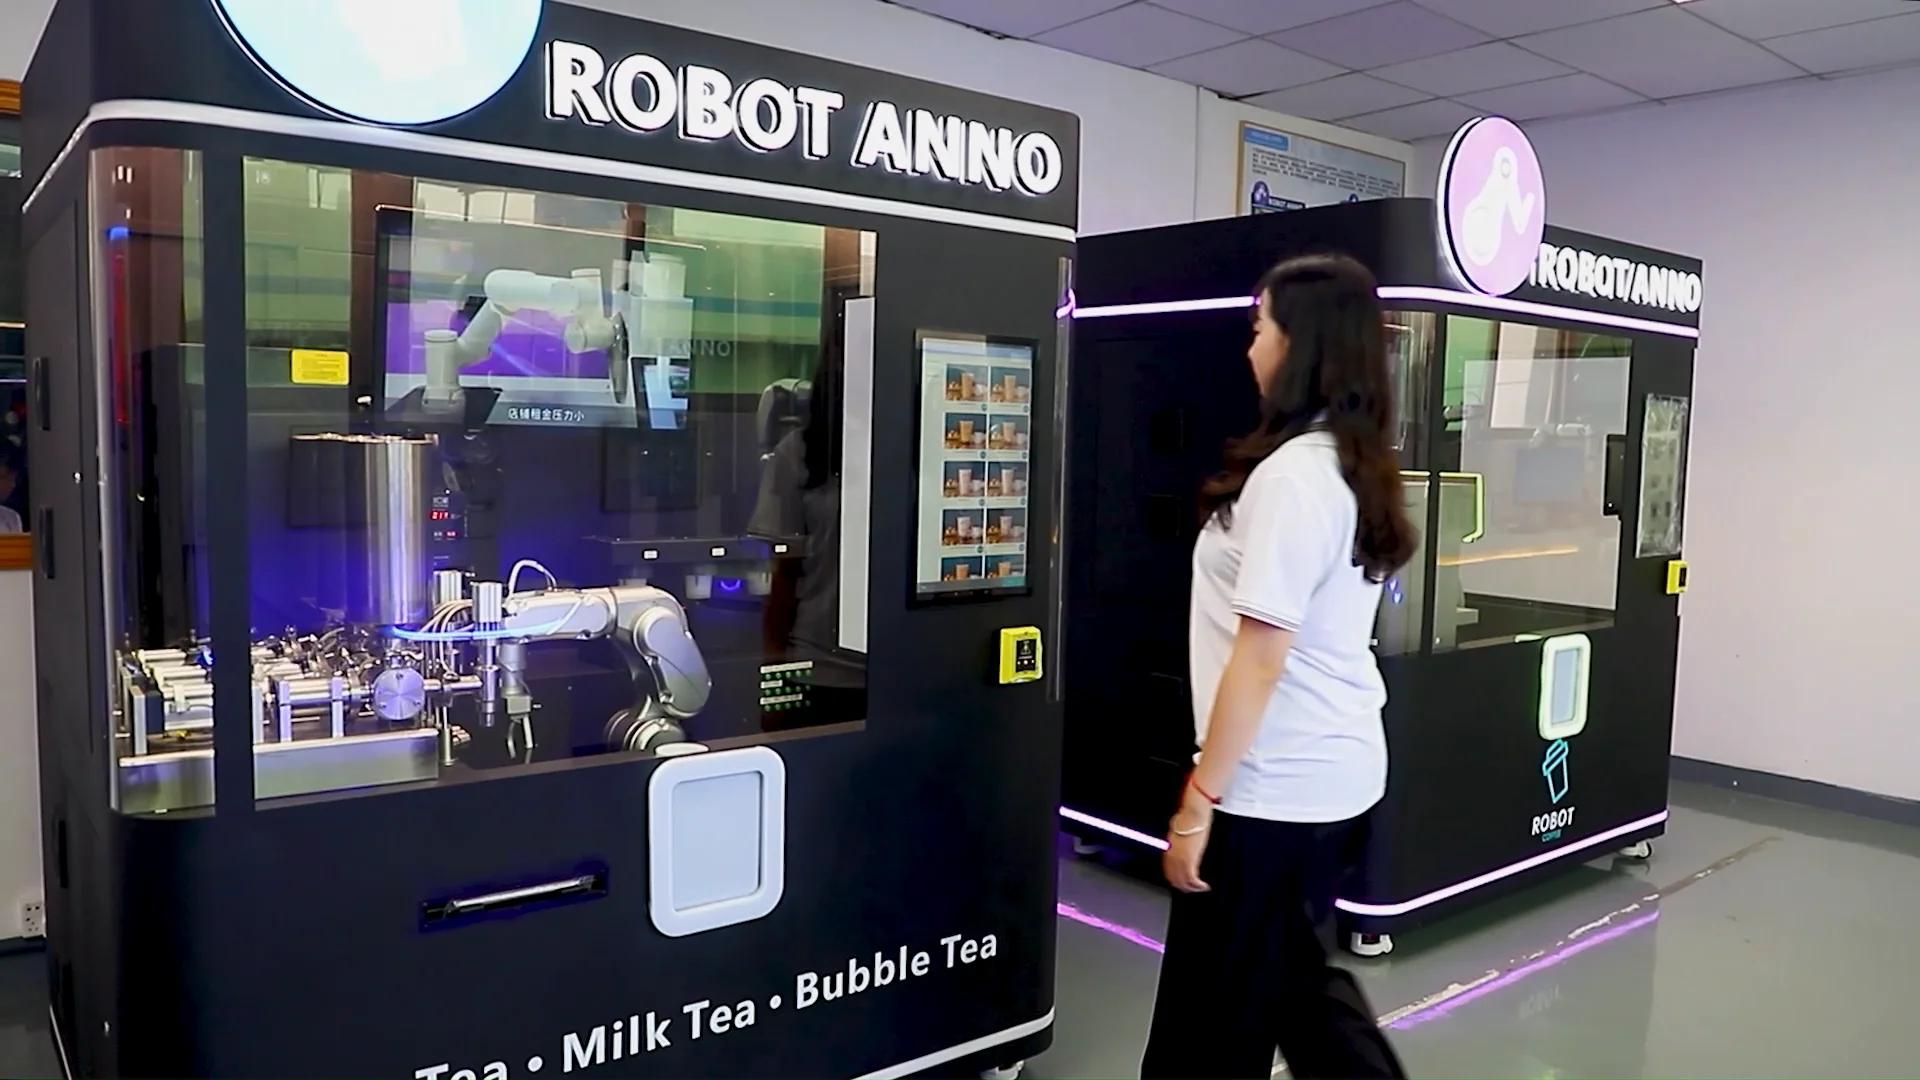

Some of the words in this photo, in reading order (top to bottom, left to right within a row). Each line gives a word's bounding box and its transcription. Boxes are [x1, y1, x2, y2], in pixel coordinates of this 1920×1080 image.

[544, 39, 844, 160] ROBOT
[851, 100, 1063, 197] ANNO
[1537, 243, 1631, 301] ROBOT
[1630, 262, 1702, 313] ANNO
[508, 407, 585, 422] 店铺租金压力小
[1531, 806, 1576, 836] ROBOT
[563, 1011, 672, 1074] Milk
[682, 999, 756, 1040] Tea
[796, 945, 931, 1010] Bubble
[940, 933, 998, 969] Tea
